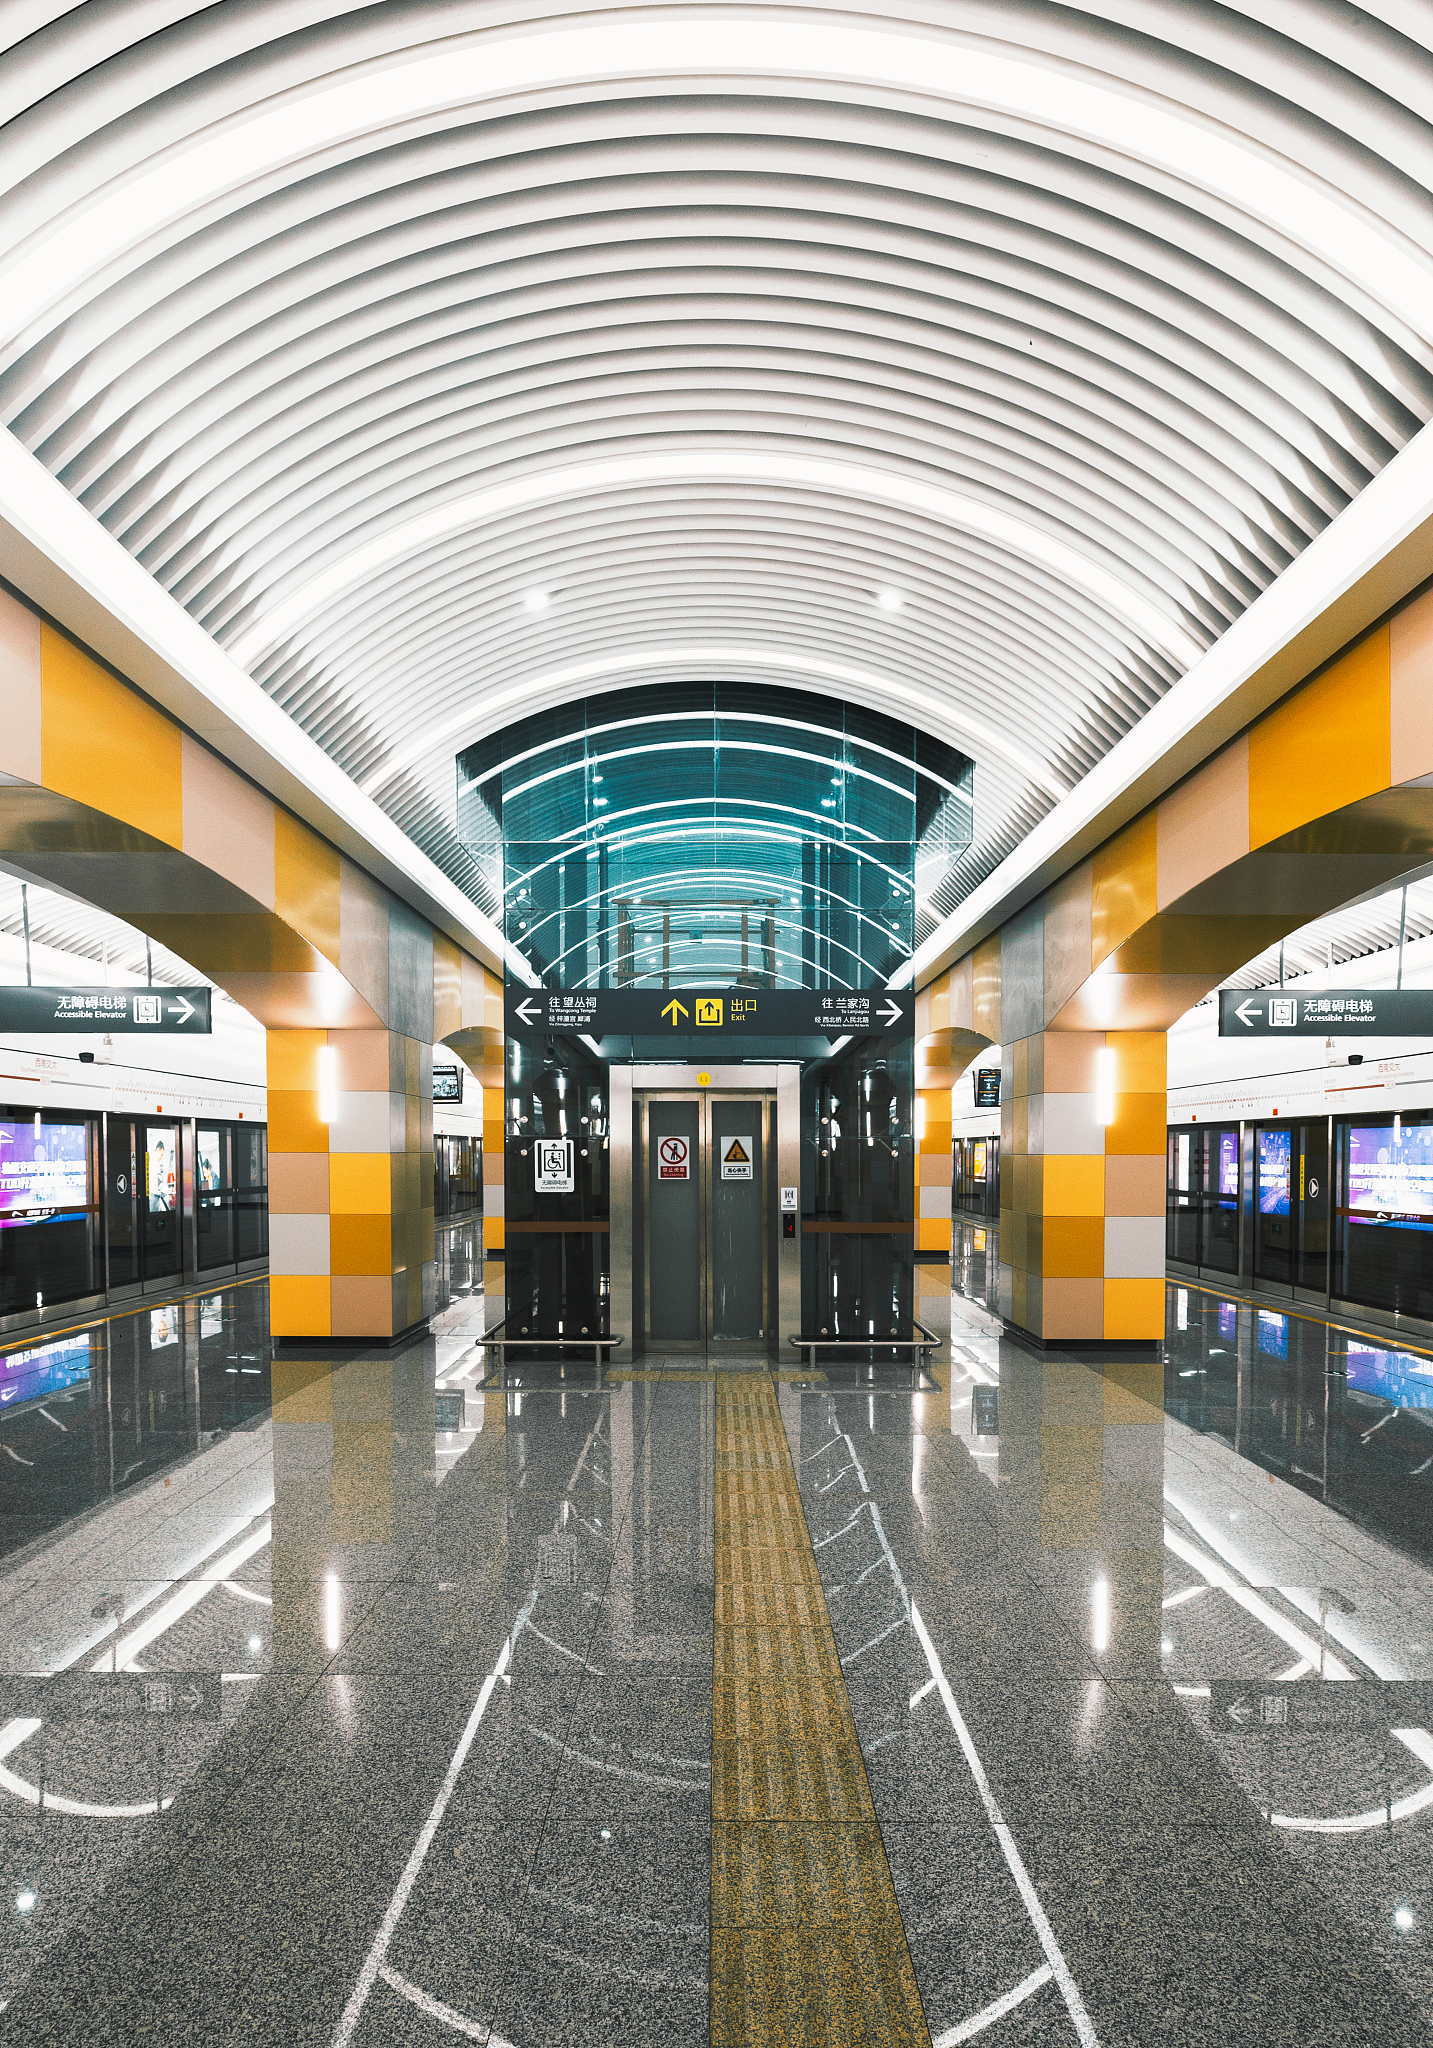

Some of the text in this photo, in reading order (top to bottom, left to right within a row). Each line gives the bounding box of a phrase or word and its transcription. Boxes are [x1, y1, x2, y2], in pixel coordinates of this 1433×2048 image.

[57, 996, 127, 1009] 无障碍电梯
[548, 996, 596, 1008] 往 望丛祠
[731, 999, 756, 1011] 出口
[822, 998, 869, 1009] 往 兰家沟
[1303, 999, 1373, 1013] 无障碍电梯
